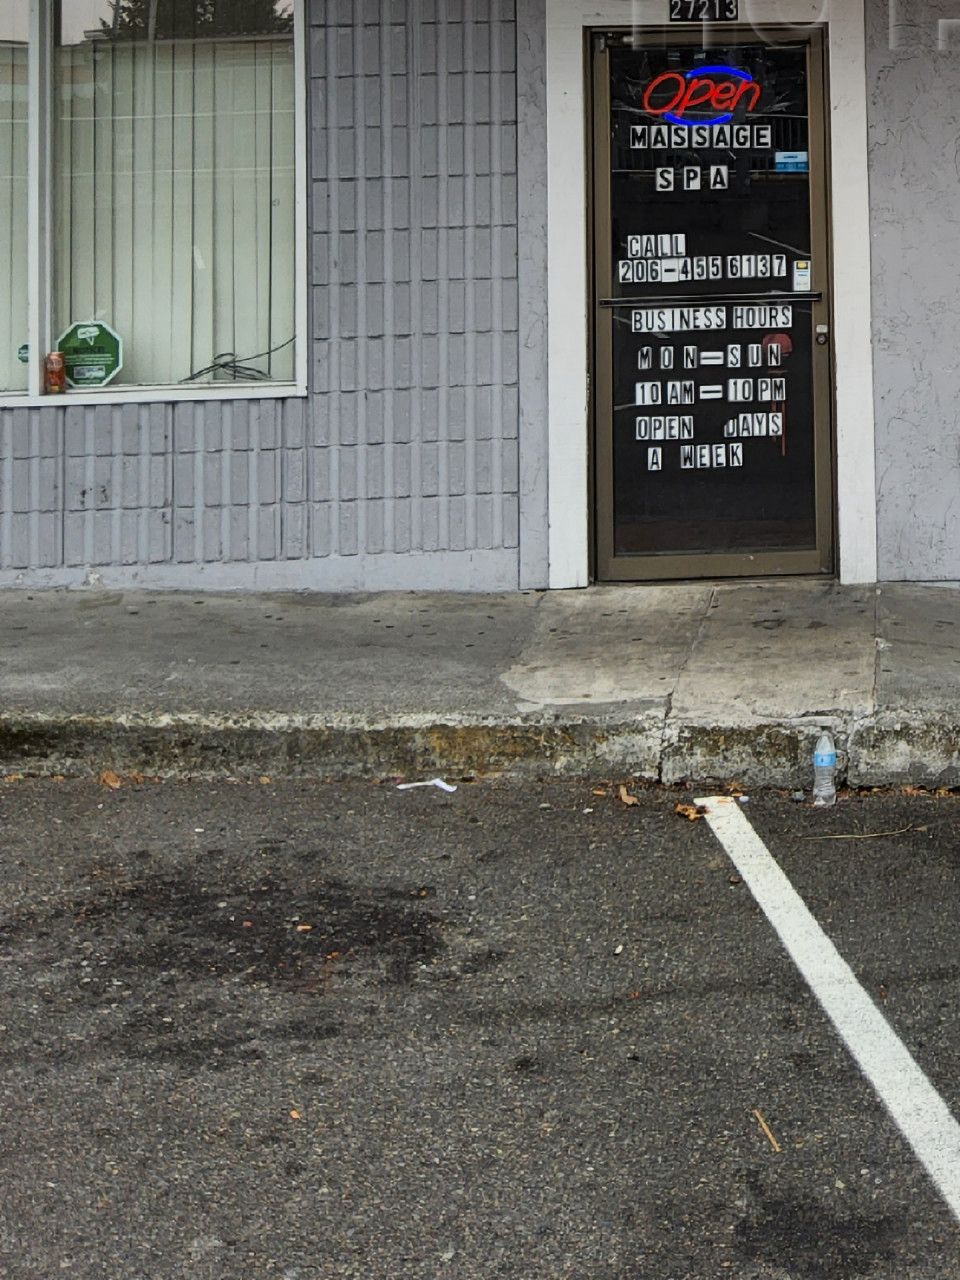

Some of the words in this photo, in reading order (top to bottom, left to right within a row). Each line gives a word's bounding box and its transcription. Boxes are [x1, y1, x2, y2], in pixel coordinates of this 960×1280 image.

[643, 72, 761, 117] Open
[631, 126, 770, 147] MASSAGE
[658, 167, 727, 189] SPA
[630, 236, 684, 256] CALL
[634, 309, 725, 331] BUSINESS
[735, 307, 790, 327] HOURS
[638, 418, 692, 439] OPEN
[651, 449, 660, 468] A
[683, 444, 741, 468] WEEK
